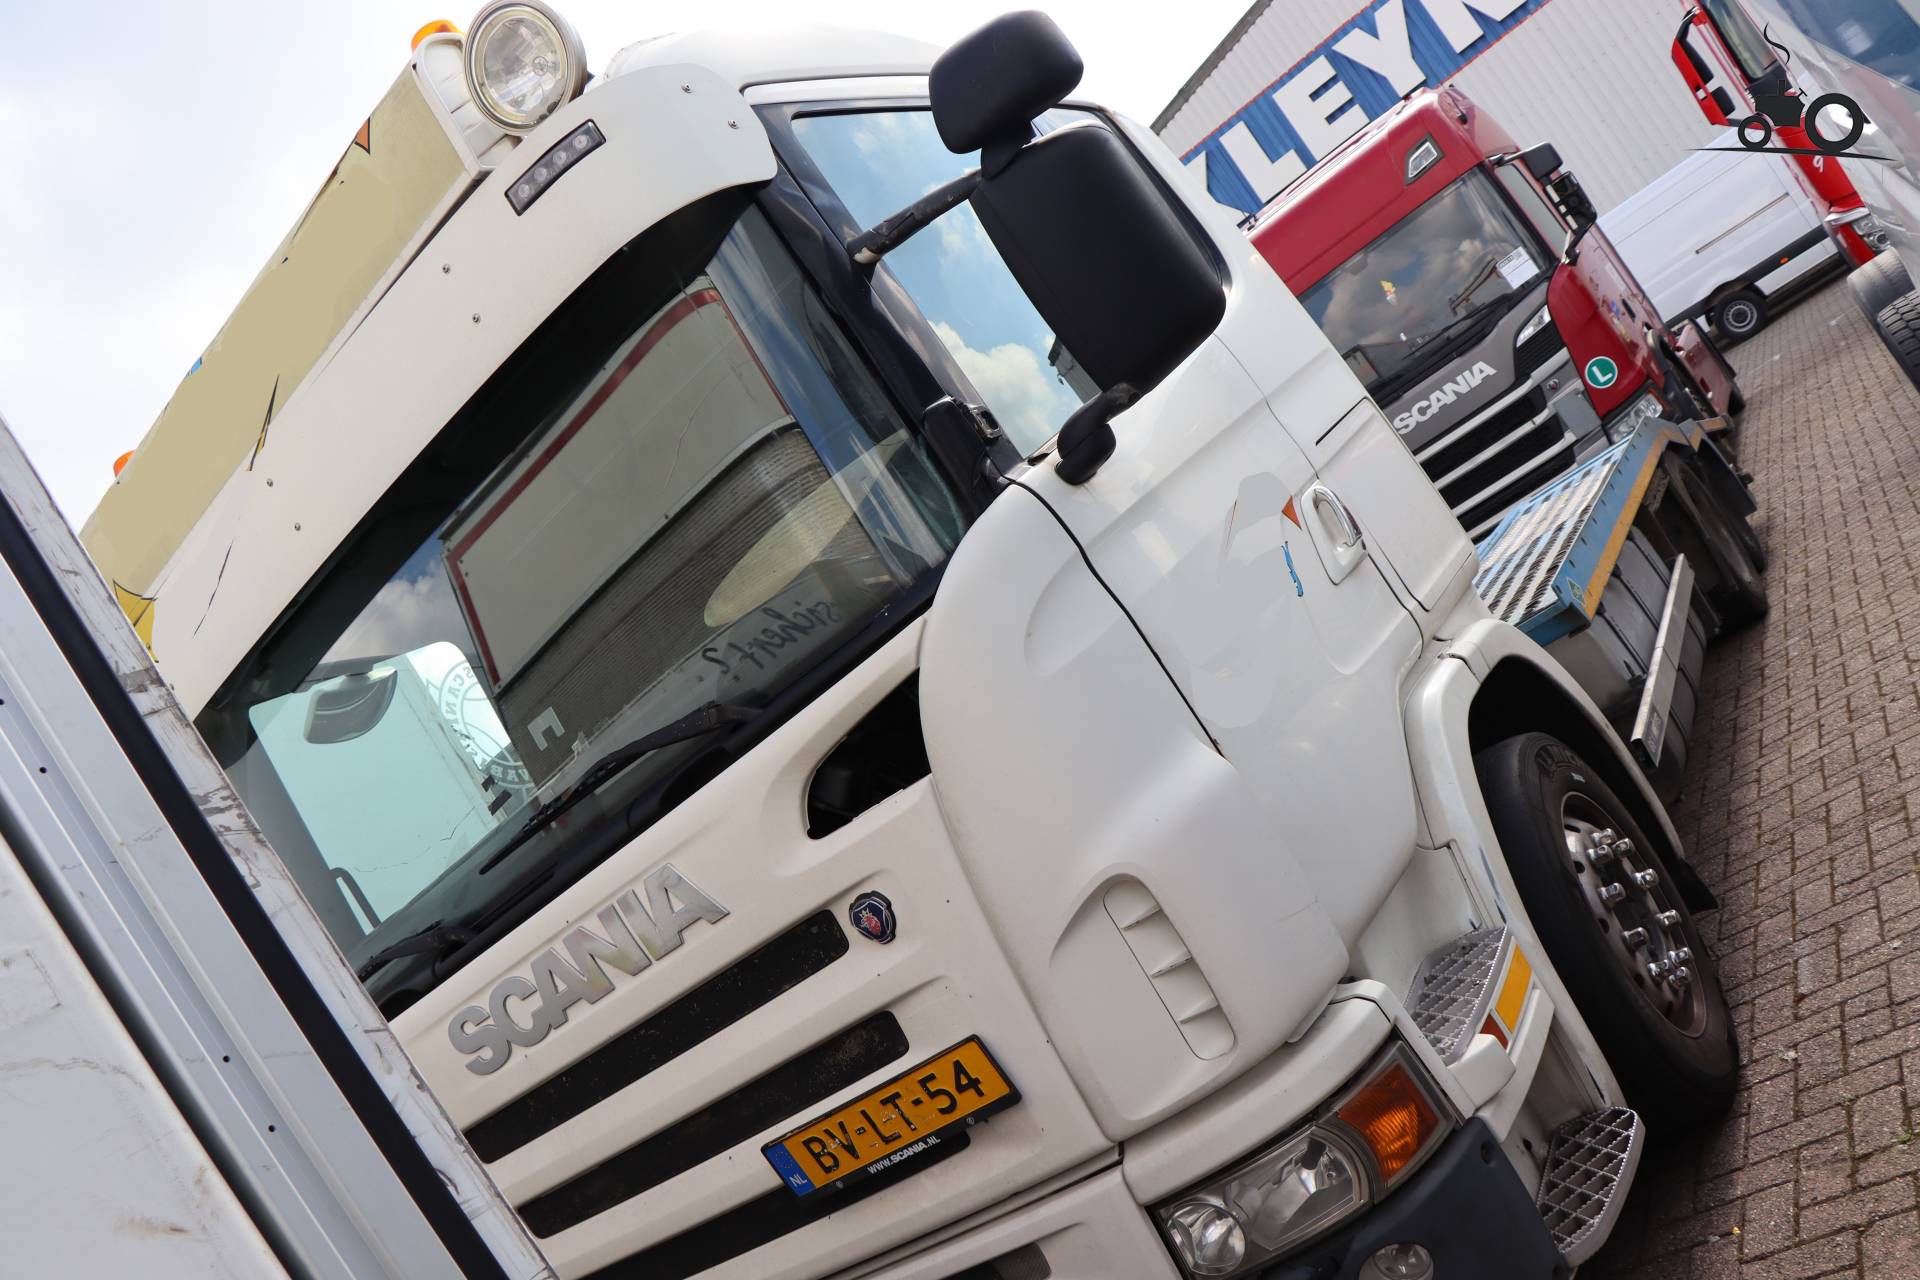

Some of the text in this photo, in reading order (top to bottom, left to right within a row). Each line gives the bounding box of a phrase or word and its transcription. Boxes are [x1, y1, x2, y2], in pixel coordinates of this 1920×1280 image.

[1184, 0, 1528, 221] LEY
[1393, 361, 1497, 435] SCANIA
[1591, 365, 1613, 383] L
[448, 862, 730, 1076] SCANIA
[802, 1059, 985, 1174] BV-LT-54
[790, 1173, 808, 1188] NL
[867, 1135, 941, 1175] WWW.SCANIA.NL
